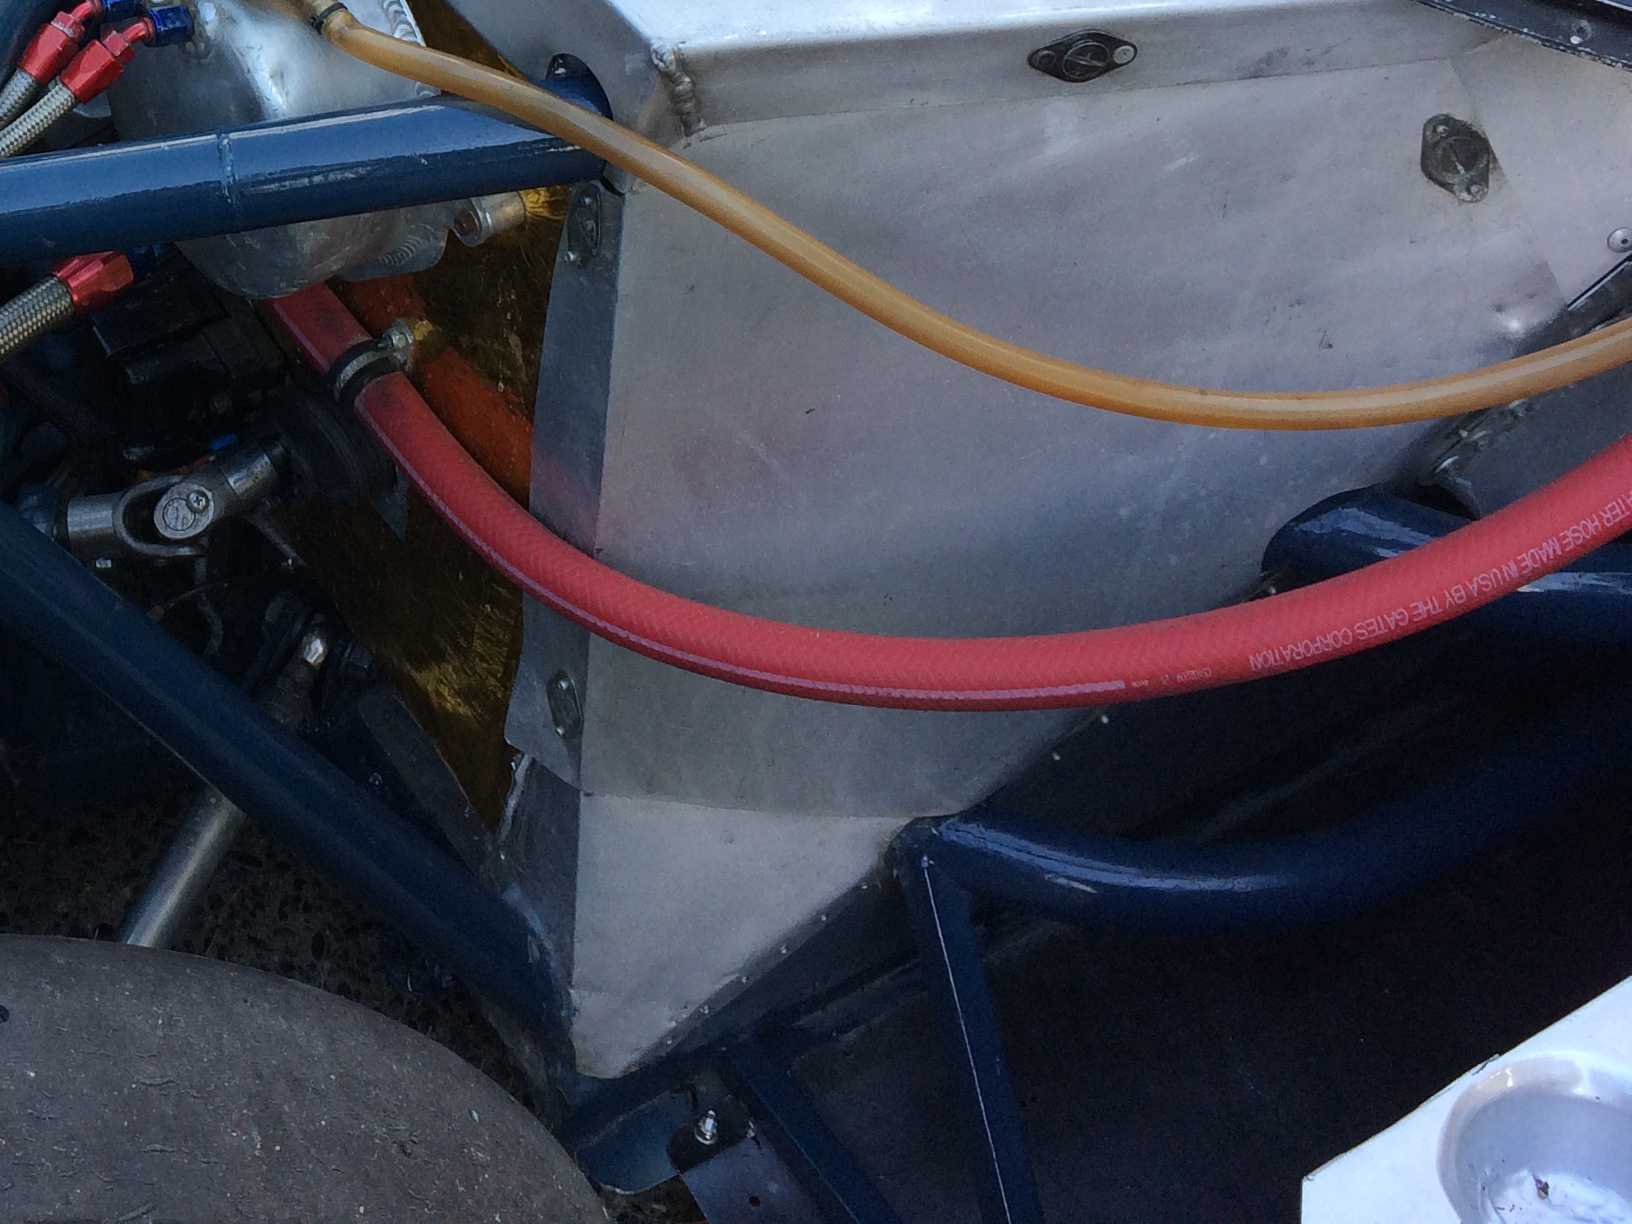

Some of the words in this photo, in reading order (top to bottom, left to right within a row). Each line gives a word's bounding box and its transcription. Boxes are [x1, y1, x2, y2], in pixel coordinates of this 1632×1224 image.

[1561, 514, 1602, 553] HOSE
[1517, 539, 1562, 576] MADE
[1468, 572, 1503, 599] USA
[1501, 564, 1518, 587] IN
[1409, 596, 1445, 622] THE
[1444, 584, 1467, 610] BY
[1353, 603, 1409, 640] GATES
[1249, 627, 1353, 671] CORPORATION
